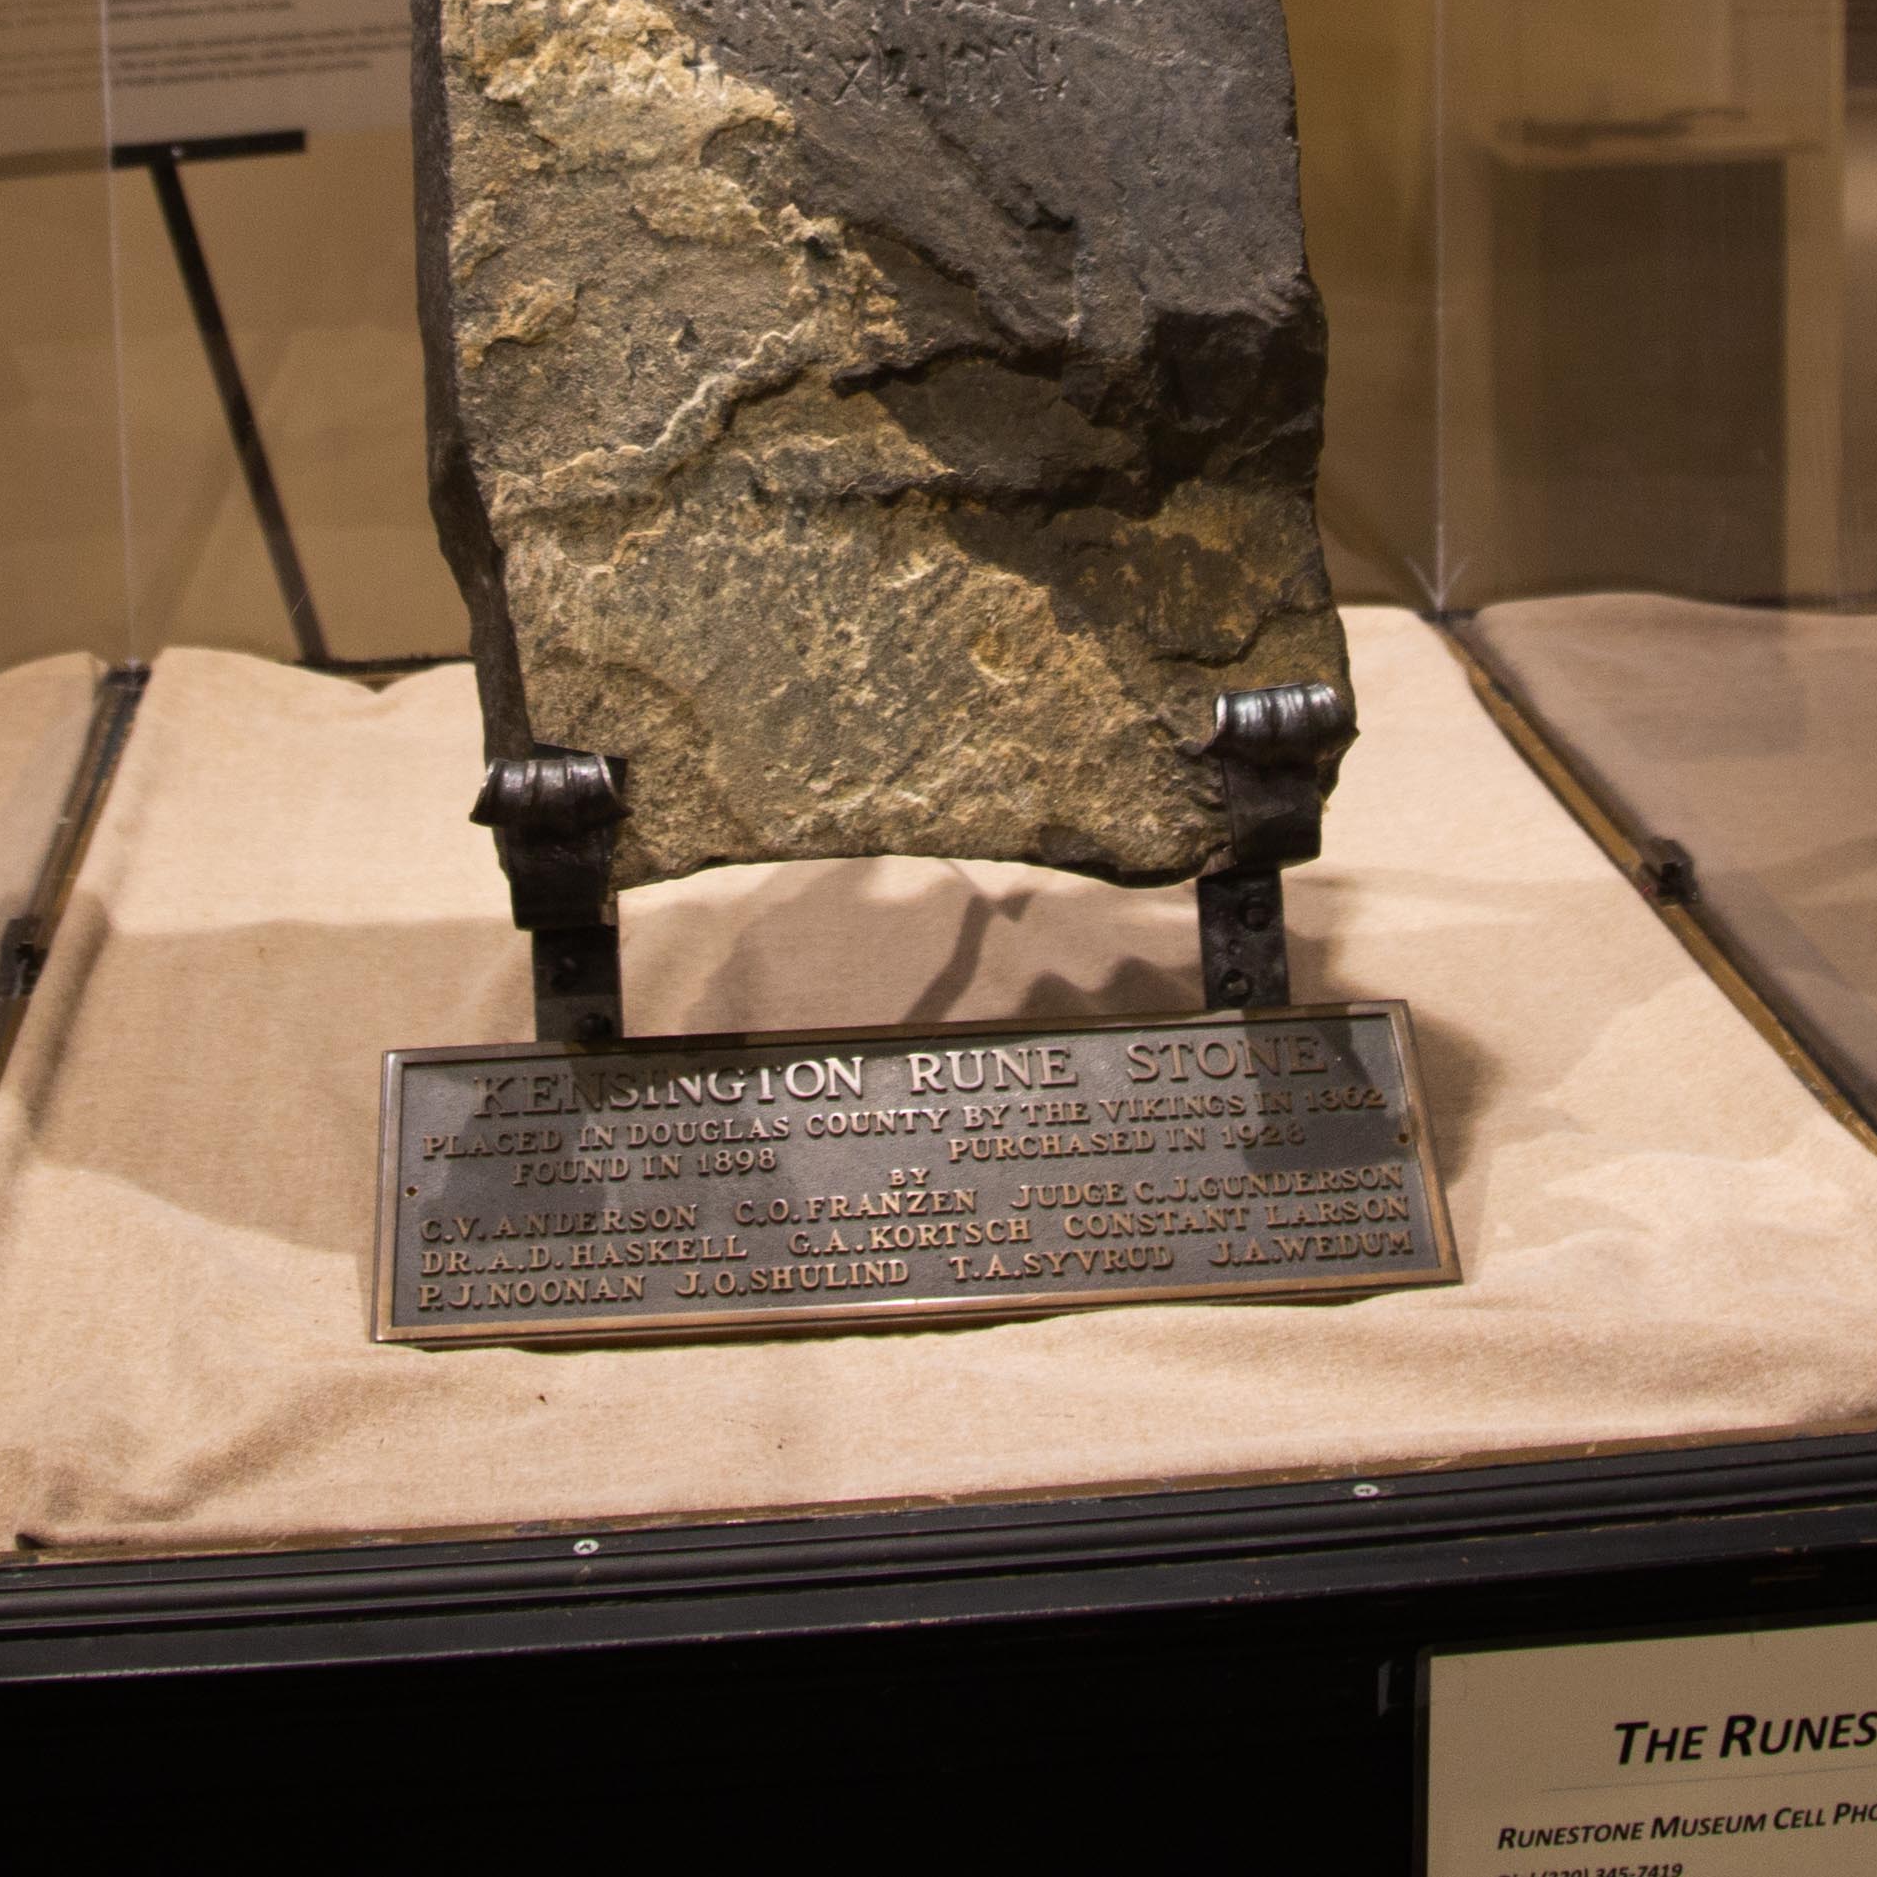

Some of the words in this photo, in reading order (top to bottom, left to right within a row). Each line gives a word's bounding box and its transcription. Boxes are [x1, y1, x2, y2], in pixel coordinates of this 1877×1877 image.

[474, 1056, 864, 1117] KENSINGTON
[907, 1046, 1077, 1094] RUNE
[1127, 1035, 1327, 1082] STONE
[423, 1129, 562, 1159] PLACED
[579, 1123, 616, 1151] IN
[629, 1116, 790, 1146] DOUGLAS
[806, 1107, 949, 1136] COUNTY
[963, 1104, 1008, 1130] BY
[1021, 1100, 1089, 1127] THE
[1099, 1091, 1245, 1123] VIKINGS
[1256, 1089, 1293, 1115] IN
[1305, 1086, 1387, 1113] 1362
[512, 1157, 630, 1185] FOUND
[643, 1153, 681, 1179] IN
[697, 1148, 776, 1176] 1898
[949, 1128, 1154, 1162] PURCHASED
[1166, 1125, 1205, 1151] IN
[890, 1167, 930, 1188] BY
[1012, 1181, 1126, 1211] JUDGE
[1063, 1206, 1250, 1240] CONSTANT
[1266, 1195, 1409, 1228] LARSON
